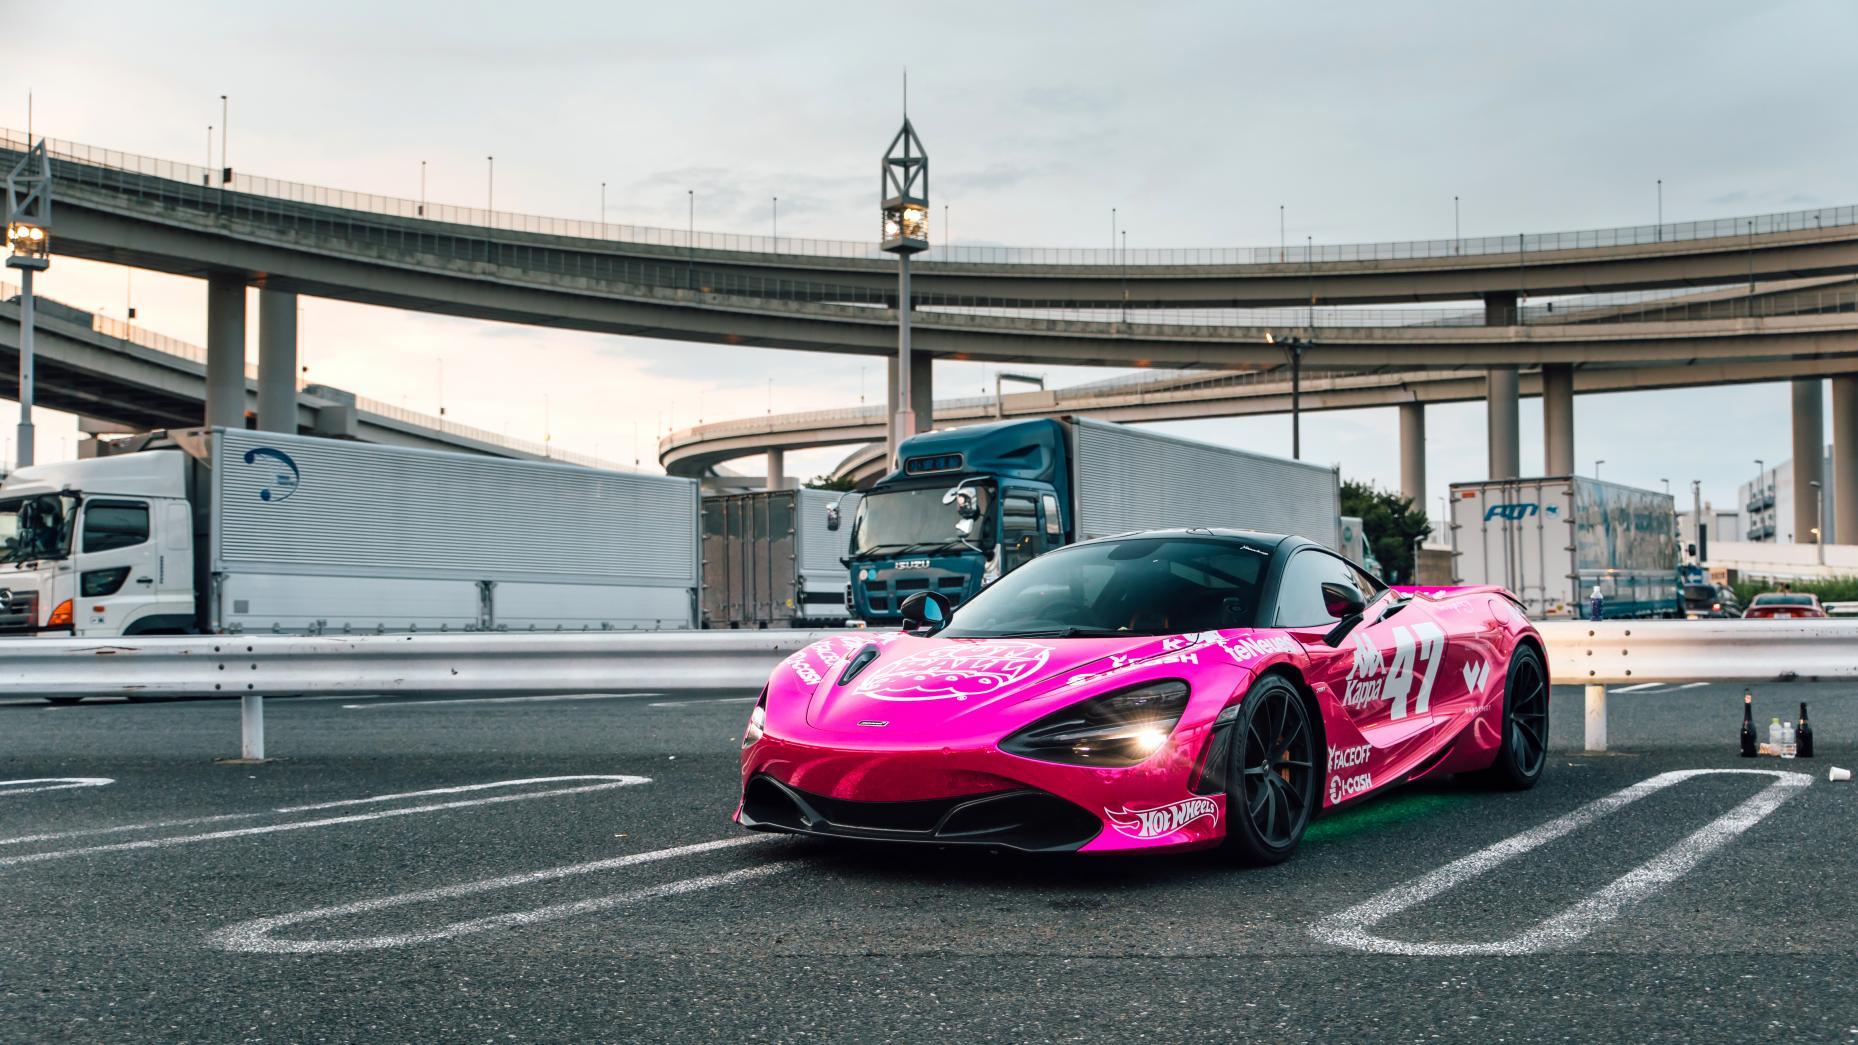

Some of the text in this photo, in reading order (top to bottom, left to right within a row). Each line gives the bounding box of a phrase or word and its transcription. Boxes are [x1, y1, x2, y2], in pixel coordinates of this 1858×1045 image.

[895, 560, 930, 570] ISUZU
[1381, 621, 1445, 720] 47
[1343, 678, 1382, 709] Kappa
[1334, 744, 1372, 770] FACEOFF
